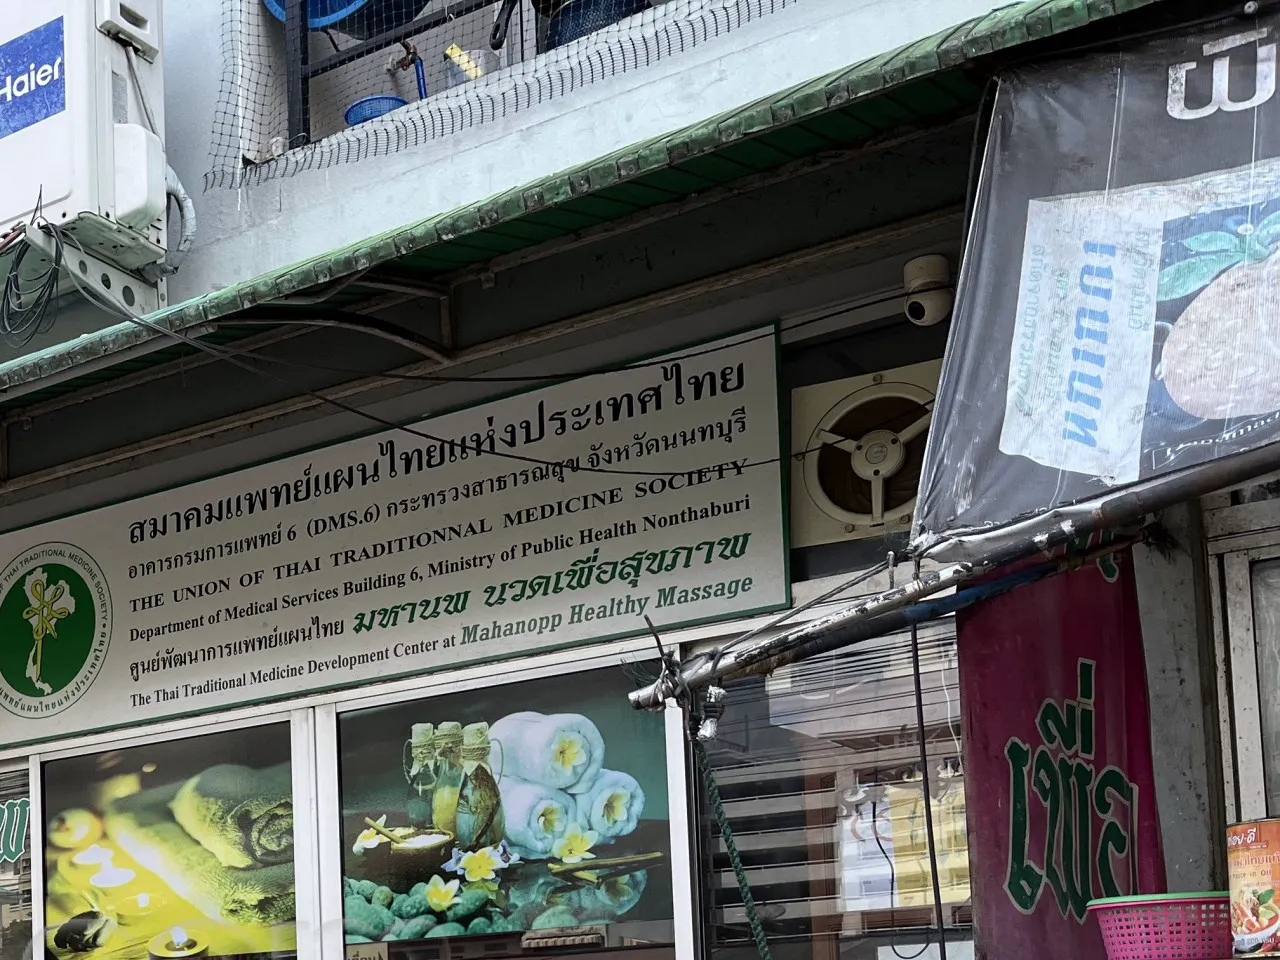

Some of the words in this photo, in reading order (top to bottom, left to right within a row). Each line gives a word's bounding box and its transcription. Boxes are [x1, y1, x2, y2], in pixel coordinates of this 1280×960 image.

[128, 362, 746, 544] สมาคมแพทย์แผนไทยแห่งประเทศไทย
[128, 522, 282, 579] อาคารกรมการแพทย์
[287, 526, 297, 541] 6
[307, 503, 381, 539] (DMS.6)
[386, 456, 580, 518] กระทรวงสาธารณสุข
[587, 406, 747, 470] จังหวัดนนทบุรี
[3, 566, 20, 583] THAI
[19, 549, 67, 568] TRADITIONAL
[67, 552, 98, 581] MEDICINE
[94, 580, 109, 622] SOCIETY
[129, 593, 165, 613] THE
[173, 577, 231, 604] UNION
[239, 570, 265, 588] OF
[273, 558, 321, 580] THAI
[330, 517, 493, 568] TRADITIONNAL
[503, 487, 623, 529] MEDICINE
[634, 458, 749, 498] SOCIETY
[129, 617, 205, 643] Department
[208, 610, 222, 625] of
[224, 594, 278, 622] Medical
[282, 586, 339, 609] Services
[343, 570, 406, 598] Building
[410, 566, 424, 584] 6,
[427, 550, 496, 579] Ministry
[500, 545, 518, 562] of
[521, 534, 574, 558] Public
[579, 520, 637, 546] Health
[642, 494, 751, 532] Nonthaburi
[129, 615, 345, 682] ศูนย์พัฒนาการแพทย์แผนไทย
[352, 590, 471, 634] มหานพ
[483, 532, 752, 608] นวดเพื่อสุขภาพ
[130, 693, 151, 708] The
[154, 687, 179, 704] Thai
[182, 674, 246, 698] Traditional
[250, 664, 304, 685] Medicine
[307, 648, 390, 676] Development
[393, 640, 437, 658] Center
[442, 635, 456, 648] at
[460, 612, 562, 645] Mahanopp
[568, 590, 649, 625] Healthy
[655, 575, 753, 609] Massage
[1003, 656, 1140, 925] เพื่อ
